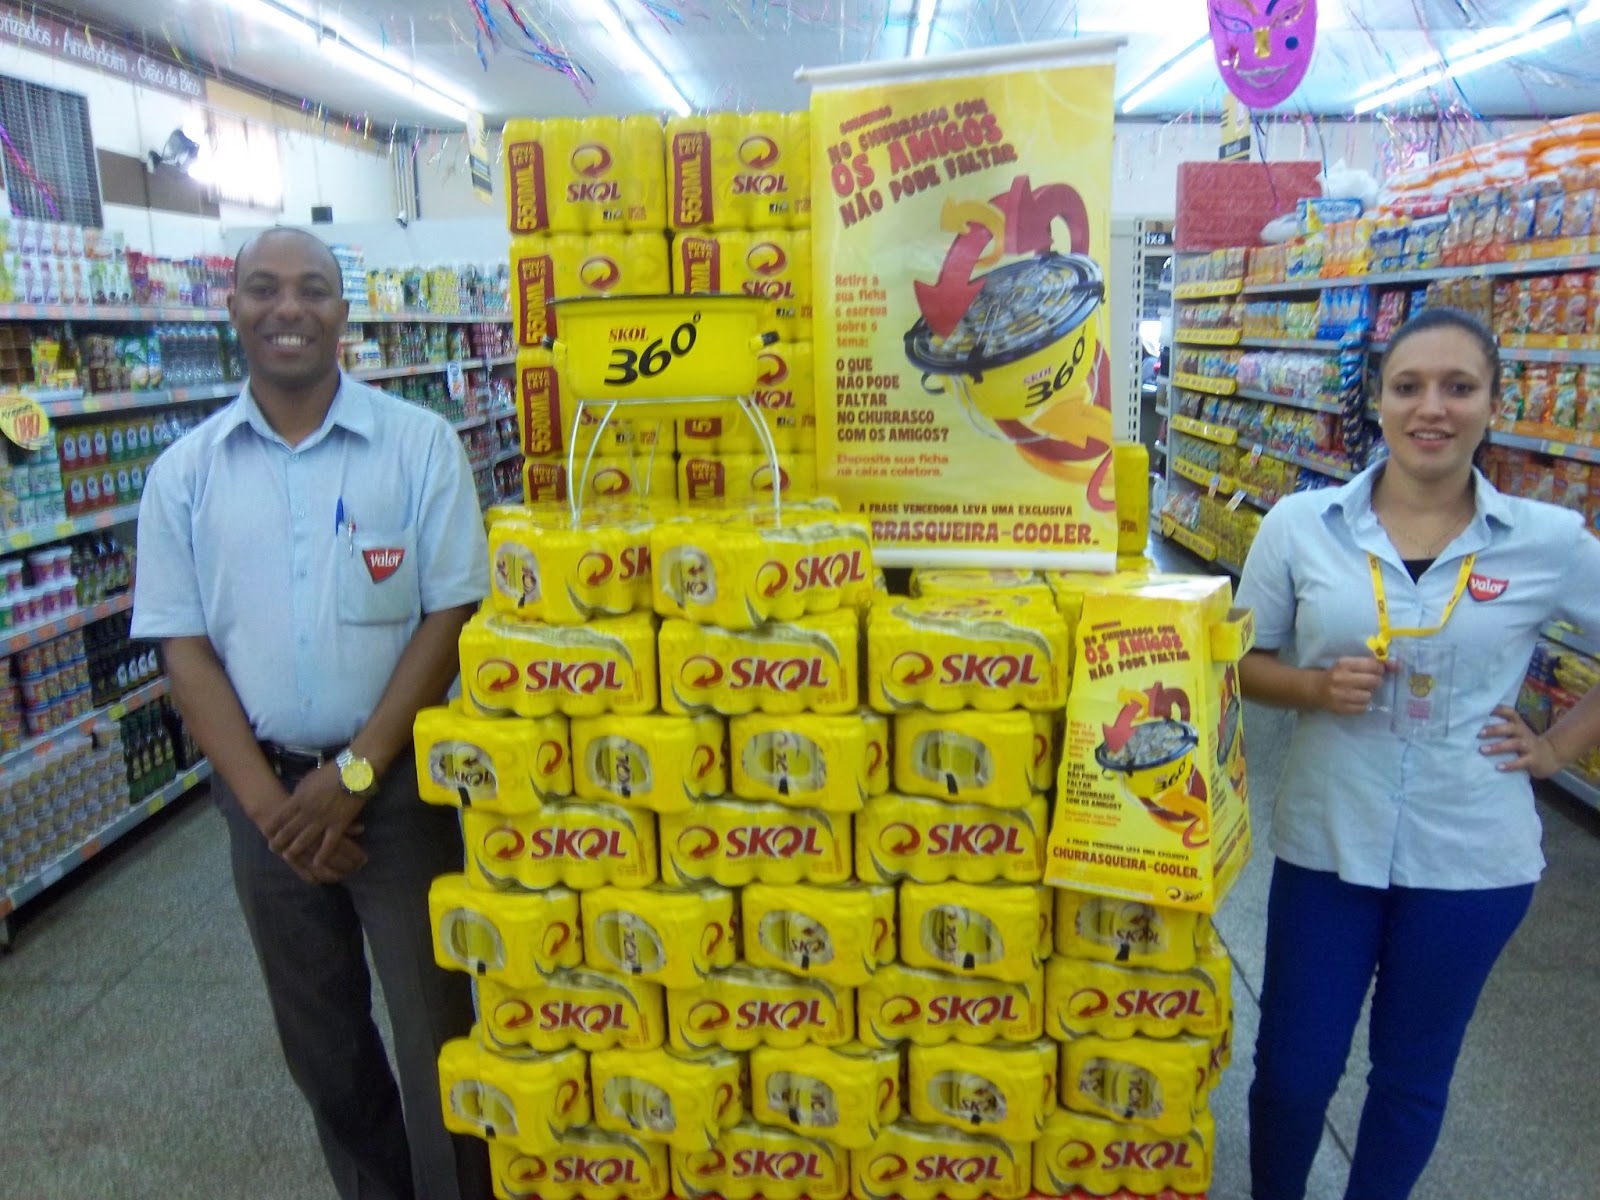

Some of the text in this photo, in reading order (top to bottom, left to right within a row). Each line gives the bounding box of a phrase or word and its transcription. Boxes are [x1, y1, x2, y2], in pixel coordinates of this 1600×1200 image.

[827, 141, 852, 166] NO
[831, 153, 875, 198] OS
[887, 113, 1003, 176] AMIGOS
[566, 182, 622, 203] SKOL
[732, 174, 789, 195] SKOL
[839, 143, 1018, 229] NÃO PODE FALTAR
[1146, 231, 1166, 245] ixa
[608, 327, 648, 343] SKOL
[836, 357, 873, 374] O QUE
[836, 374, 899, 389] NÃO PODE
[836, 393, 887, 407] FALTAR
[837, 410, 935, 424] NO CHURRASCO
[837, 428, 949, 443] COM OS AMIGOS?
[859, 503, 1073, 516] A FRASE VENCEDORA LEVA UMA EXCLUSIVA
[793, 550, 866, 593] SKOL
[1085, 633, 1184, 665] OS AMIGOS
[524, 661, 623, 695] SKOL
[729, 657, 829, 692] SKOL
[938, 654, 1042, 689] SKOL
[530, 827, 628, 862] SKOL
[725, 825, 824, 859] SKOL
[926, 823, 1025, 856] SKOL
[538, 1001, 630, 1034] SKOL
[735, 999, 827, 1031] SKOL
[927, 995, 1019, 1026] SKOL
[1114, 988, 1206, 1020] SKOL
[732, 1150, 824, 1180] SKOL
[913, 1155, 1004, 1184] SKOL
[1101, 1141, 1194, 1170] SKOL
[552, 1157, 641, 1187] SKOL
